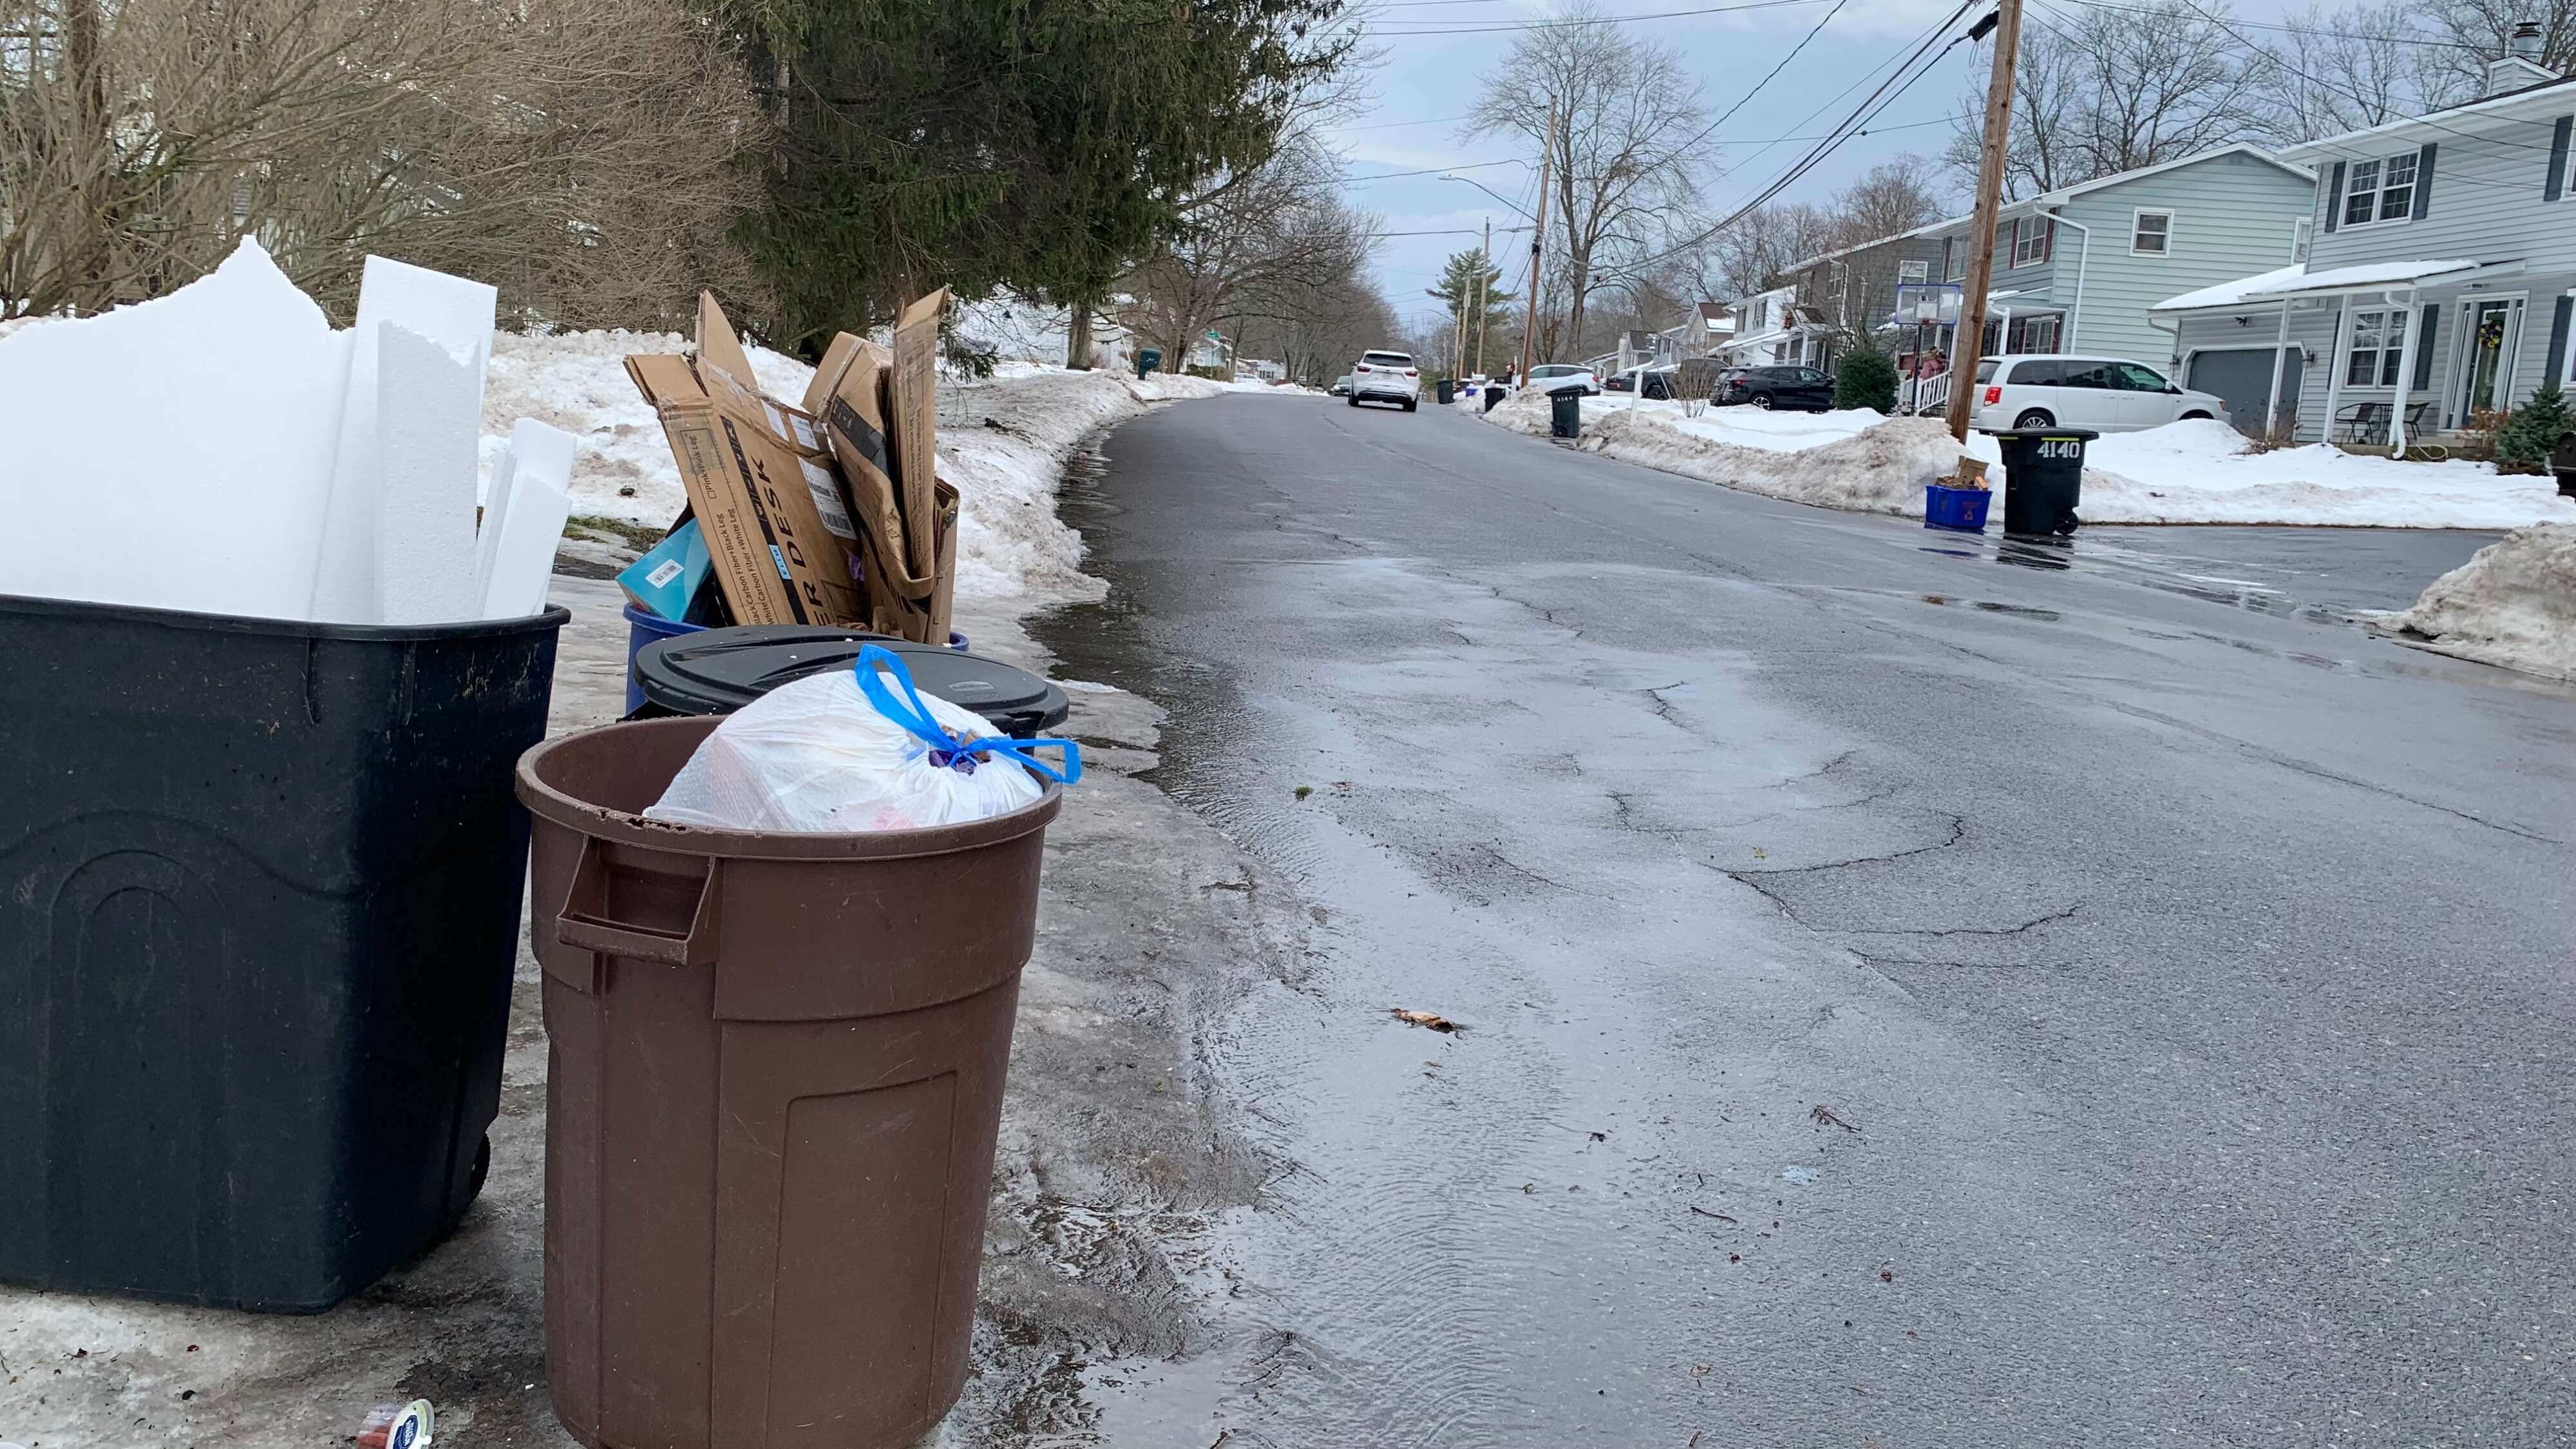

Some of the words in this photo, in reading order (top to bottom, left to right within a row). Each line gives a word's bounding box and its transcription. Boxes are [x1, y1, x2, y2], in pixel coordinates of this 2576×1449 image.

[2037, 441, 2080, 458] 4140
[717, 513, 725, 528] Leg
[728, 508, 737, 523] Leg
[750, 455, 807, 568] DESK
[743, 553, 755, 572] Fiber
[739, 576, 753, 604] Carbon
[752, 573, 766, 601] Carbon
[762, 602, 774, 625] White
